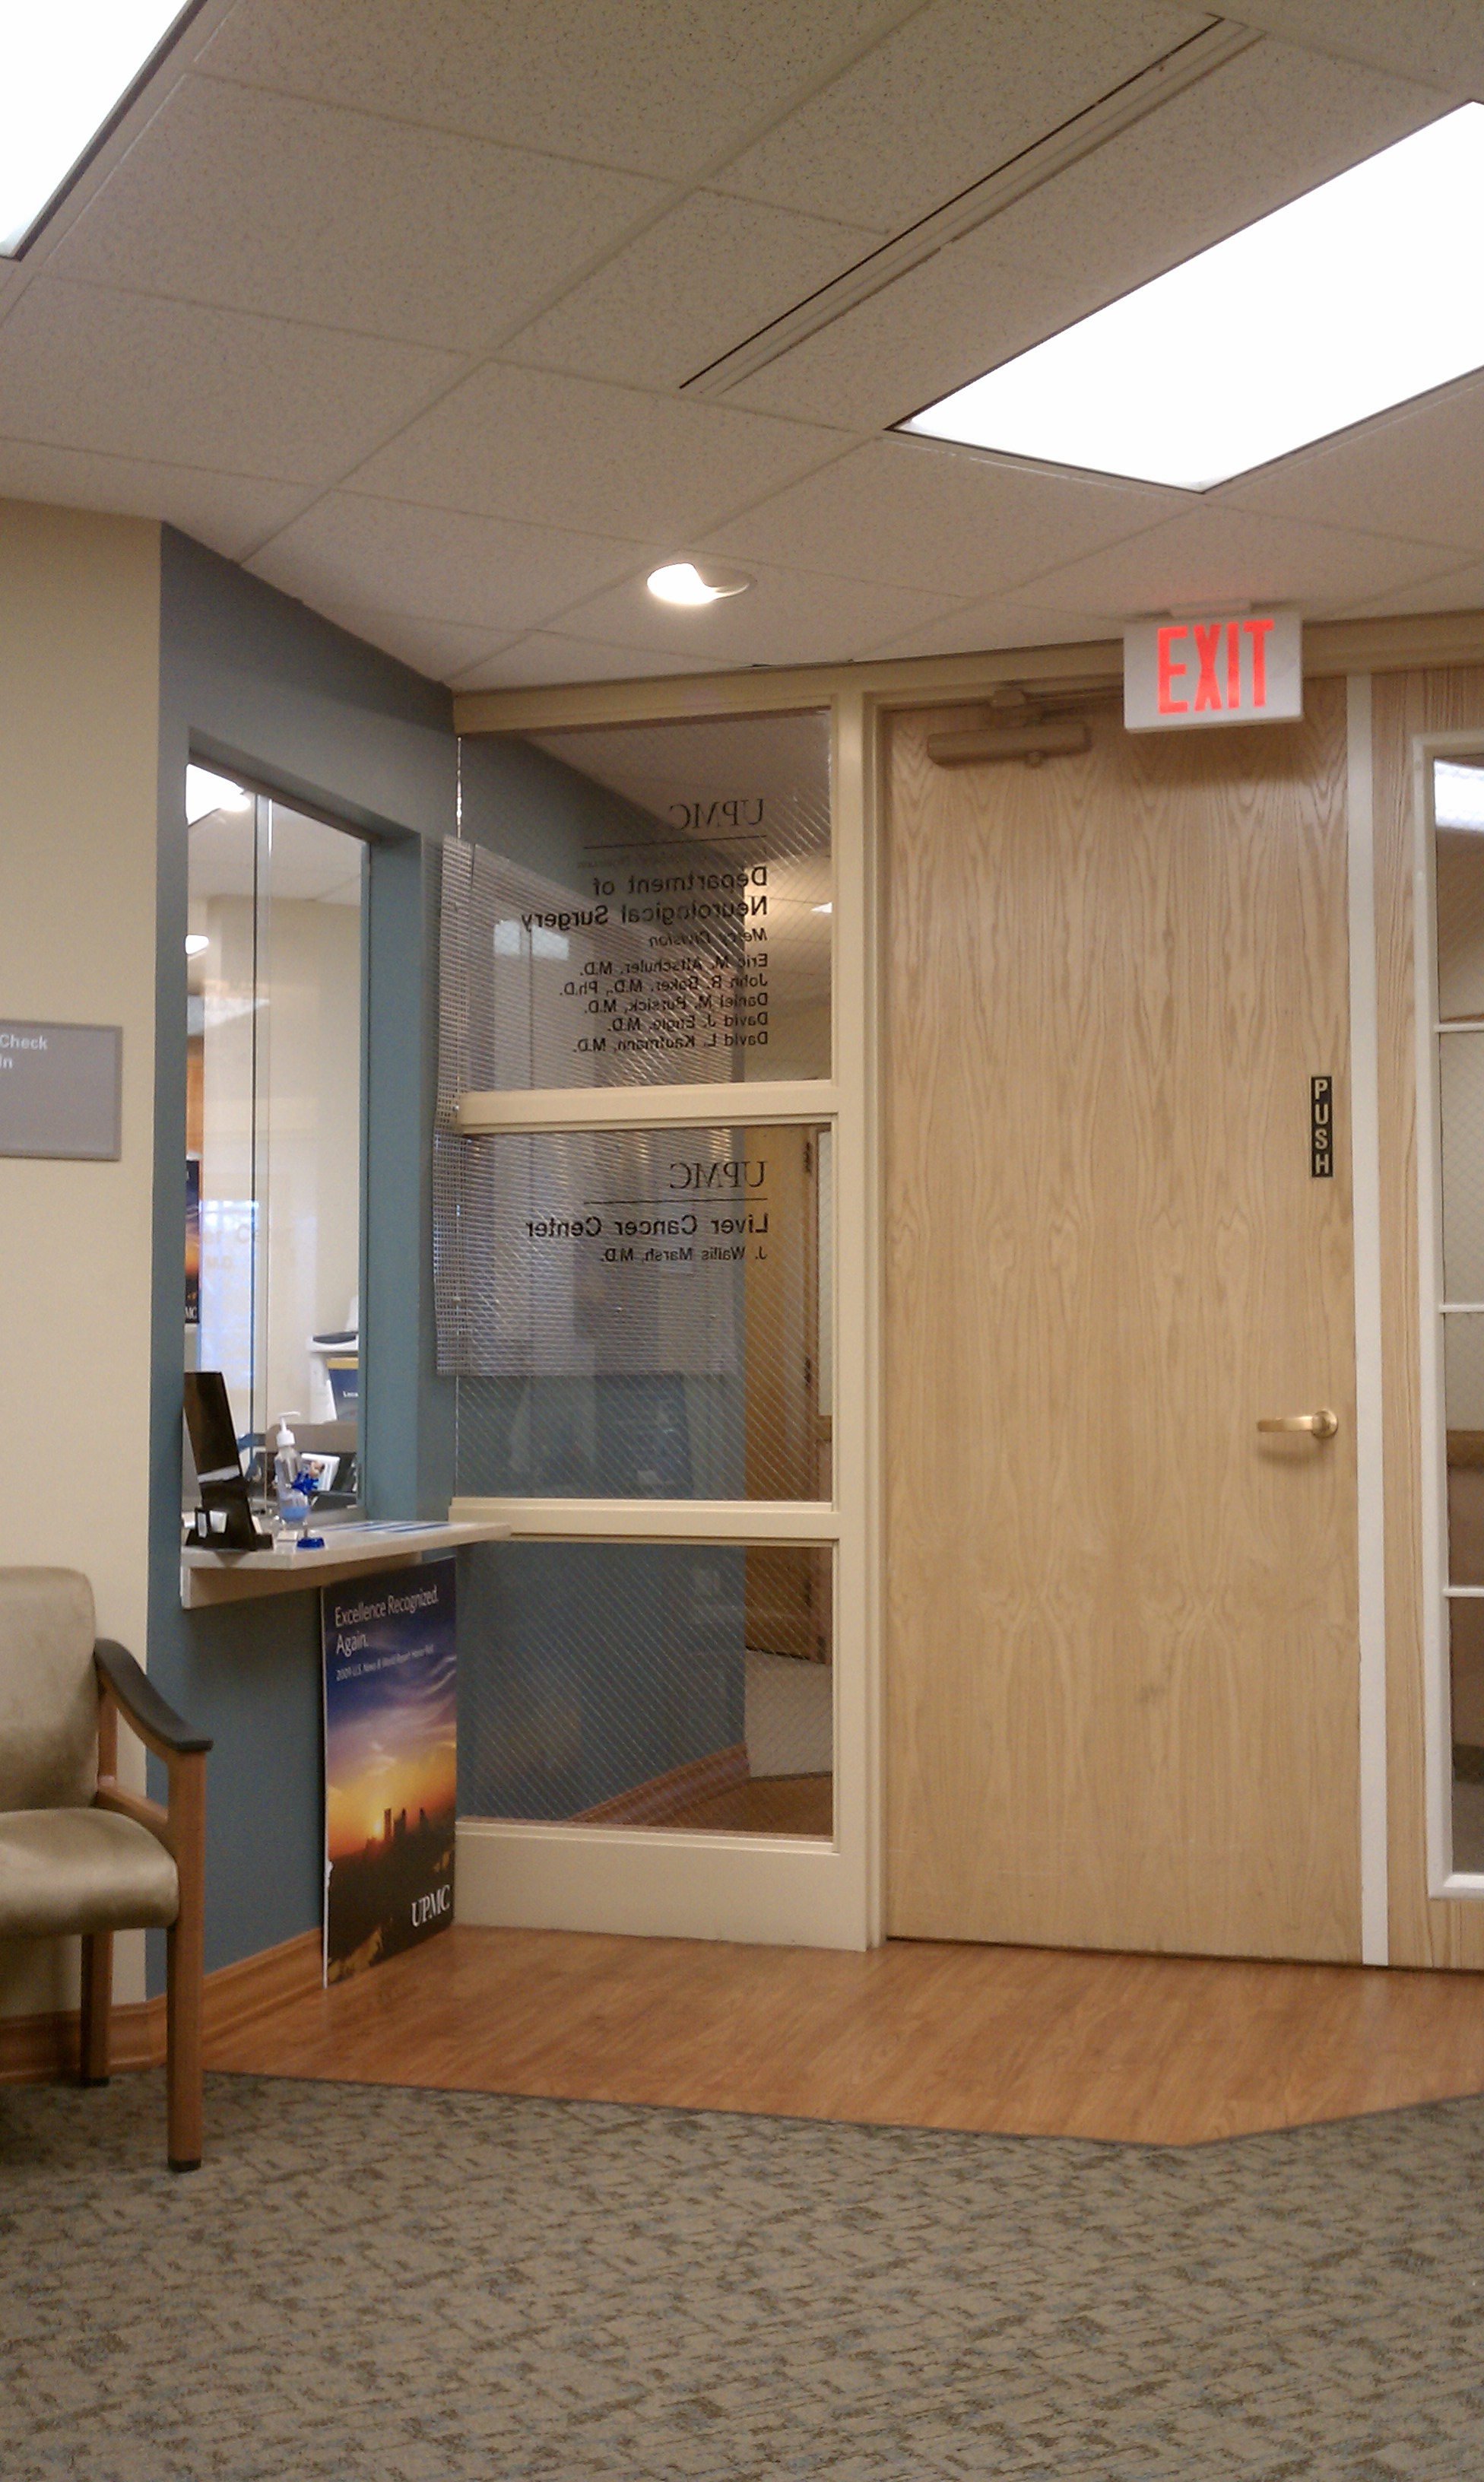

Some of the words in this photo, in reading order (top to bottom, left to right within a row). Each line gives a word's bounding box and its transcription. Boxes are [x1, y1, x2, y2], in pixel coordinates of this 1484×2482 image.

[1157, 619, 1274, 715] EXIT
[0, 1034, 48, 1050] Check
[1314, 1079, 1330, 1175] PUSH
[335, 1601, 386, 1627] Excellence
[411, 1884, 451, 1927] UPMC
